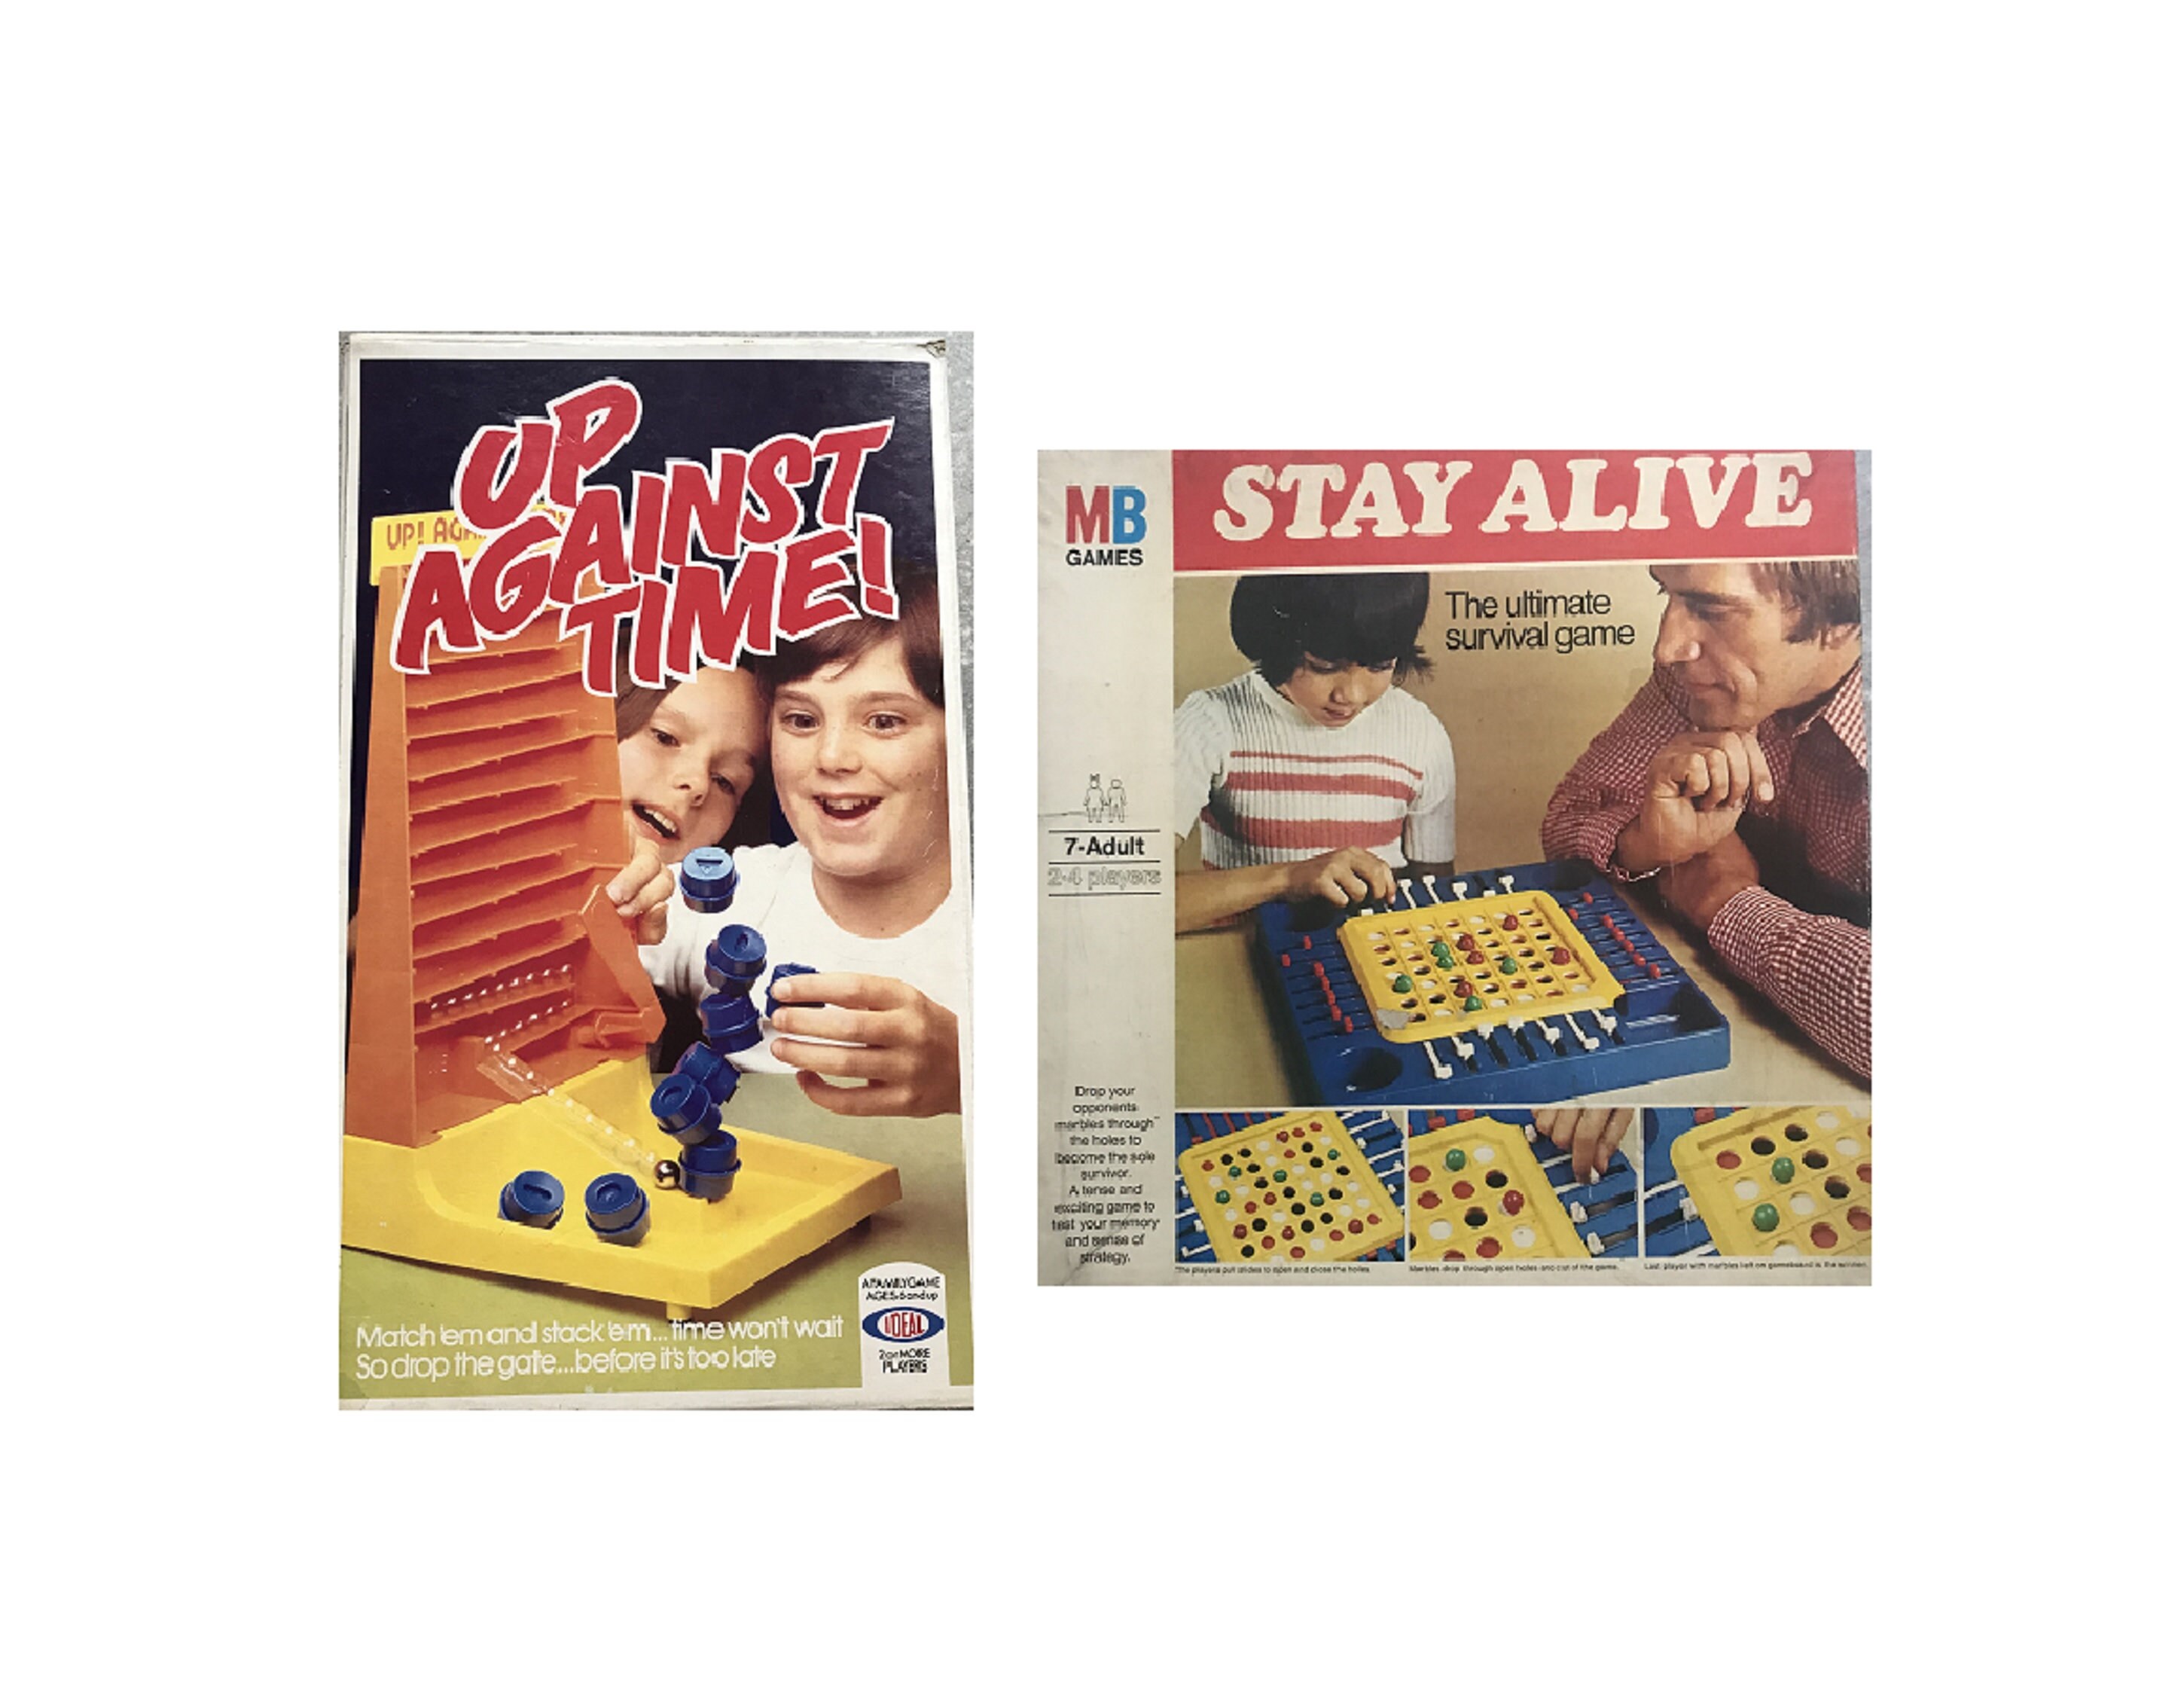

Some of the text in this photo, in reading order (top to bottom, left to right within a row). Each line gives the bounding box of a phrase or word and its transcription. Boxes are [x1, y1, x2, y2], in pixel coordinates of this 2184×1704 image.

[456, 377, 641, 530] UP
[1212, 453, 1813, 540] STAY ALIVE
[1066, 486, 1147, 544] MB
[387, 521, 424, 549] UP!
[391, 417, 895, 673] AGAINST
[1066, 548, 1143, 566] GAMES
[560, 515, 899, 696] TIME!
[1444, 589, 1611, 619] The ultimate
[1445, 621, 1635, 654] survival game
[1064, 836, 1145, 855] 7-Adult
[1088, 866, 1161, 890] players
[1075, 1086, 1136, 1100] Drop your
[1054, 1118, 1154, 1131] marbles through
[1069, 1135, 1142, 1146] the holes to
[1054, 1151, 1155, 1164] become the sole
[1069, 1184, 1143, 1195] A tense and
[1054, 1202, 1155, 1214] exciting game to
[1052, 1218, 1158, 1232] test your memory
[1065, 1234, 1145, 1247] and sense of
[907, 1276, 940, 1288] GAME
[907, 1290, 925, 1299] and
[926, 1292, 938, 1301] up
[356, 1323, 435, 1348] Match
[487, 1321, 537, 1344] and
[542, 1319, 605, 1343] stack
[672, 1318, 724, 1341] time
[727, 1316, 789, 1339] won't
[793, 1315, 844, 1338] wait
[885, 1312, 925, 1337] IDEAL
[900, 1348, 930, 1358] MORE
[355, 1353, 388, 1379] So
[391, 1353, 450, 1382] drop
[454, 1351, 494, 1377] the
[660, 1346, 684, 1370] it's
[688, 1345, 730, 1370] too
[732, 1345, 776, 1368] late
[883, 1360, 927, 1373] PLAYERS
